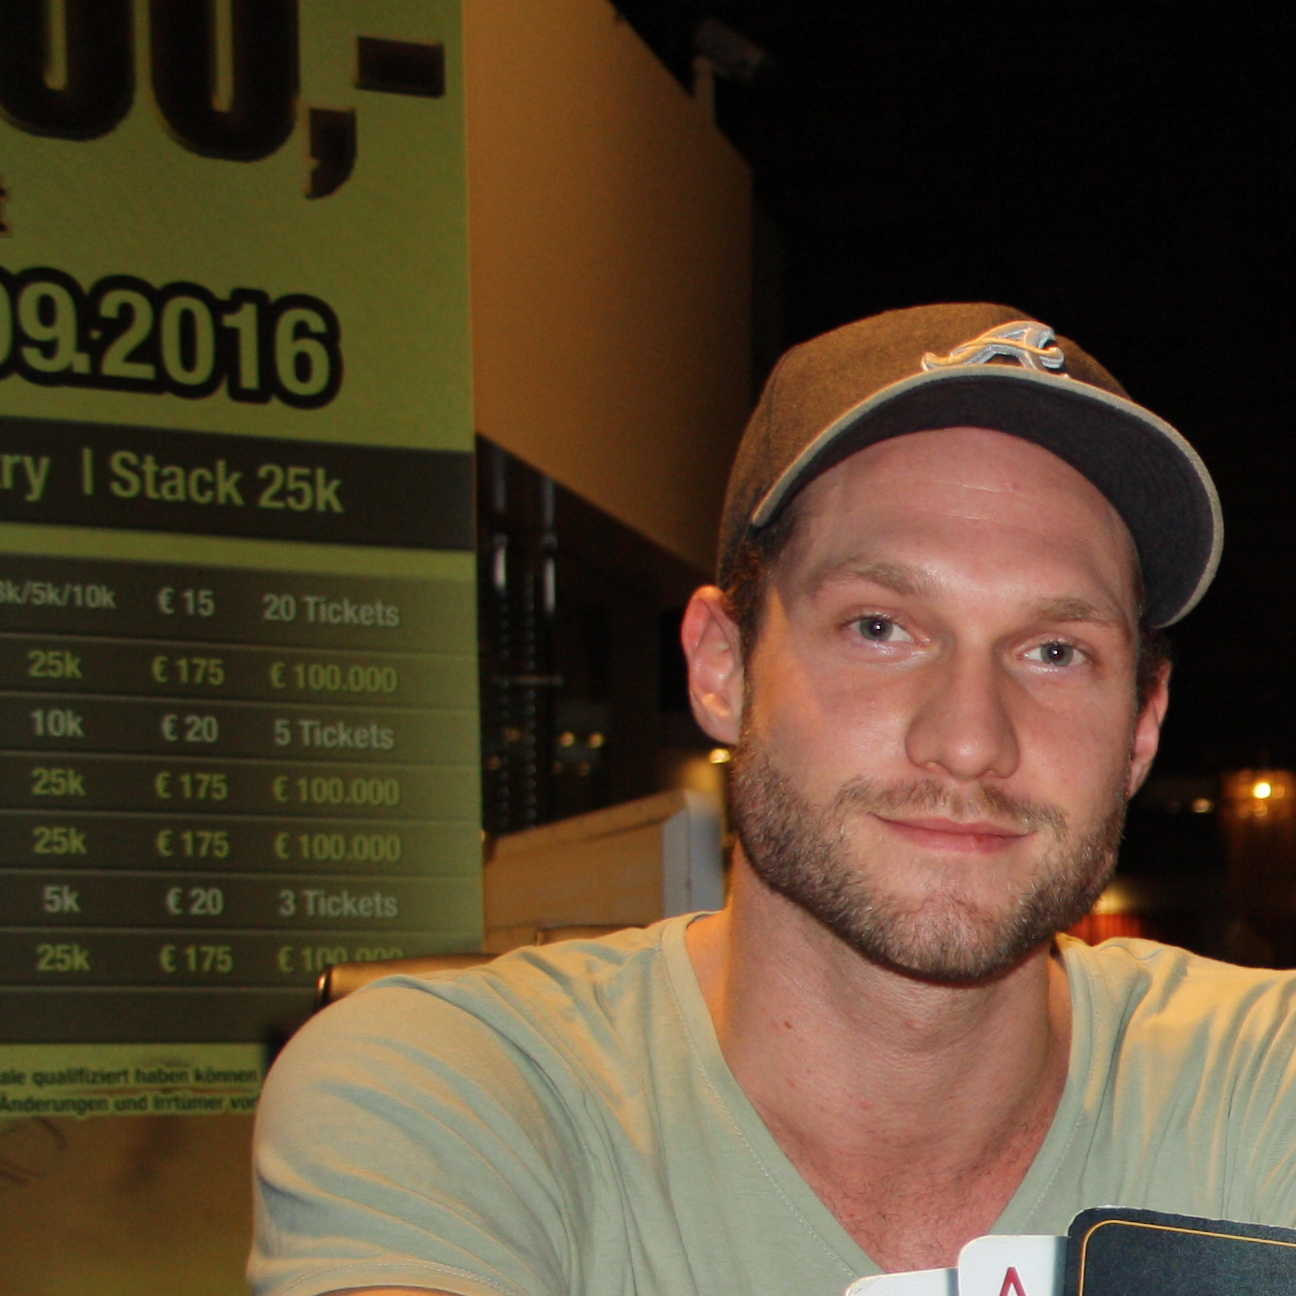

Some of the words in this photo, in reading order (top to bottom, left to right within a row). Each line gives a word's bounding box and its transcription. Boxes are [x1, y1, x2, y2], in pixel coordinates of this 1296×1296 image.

[0, 267, 344, 411] 9.2016
[110, 450, 244, 506] Stack
[257, 463, 345, 513] 25k
[157, 587, 175, 615] €
[183, 588, 215, 616] 15
[262, 594, 296, 623] 20
[305, 595, 401, 628] Tickets
[28, 650, 82, 680] 25k
[151, 656, 169, 685] €
[176, 657, 225, 687] 175
[270, 661, 287, 690] €
[295, 663, 399, 694] 100.000
[31, 709, 85, 739] 10k
[161, 713, 178, 743] €
[185, 715, 219, 744] 20
[274, 718, 292, 746] 5
[301, 719, 395, 750] Tickets
[31, 768, 86, 797] 25k
[155, 772, 172, 799] €
[181, 772, 228, 801] 175
[273, 775, 290, 803] €
[298, 777, 401, 807] 100.000
[33, 827, 87, 856] 25k
[157, 830, 174, 858] €
[182, 831, 229, 860] 175
[275, 833, 292, 860] €
[299, 834, 402, 863] 100.000
[43, 886, 81, 914] 5k
[166, 888, 183, 916] €
[189, 888, 224, 917] 20
[279, 889, 296, 918] 3
[303, 889, 399, 919] Tickets
[37, 944, 91, 973] 25k
[160, 946, 177, 973] €
[185, 946, 233, 975] 175
[278, 947, 294, 974] €
